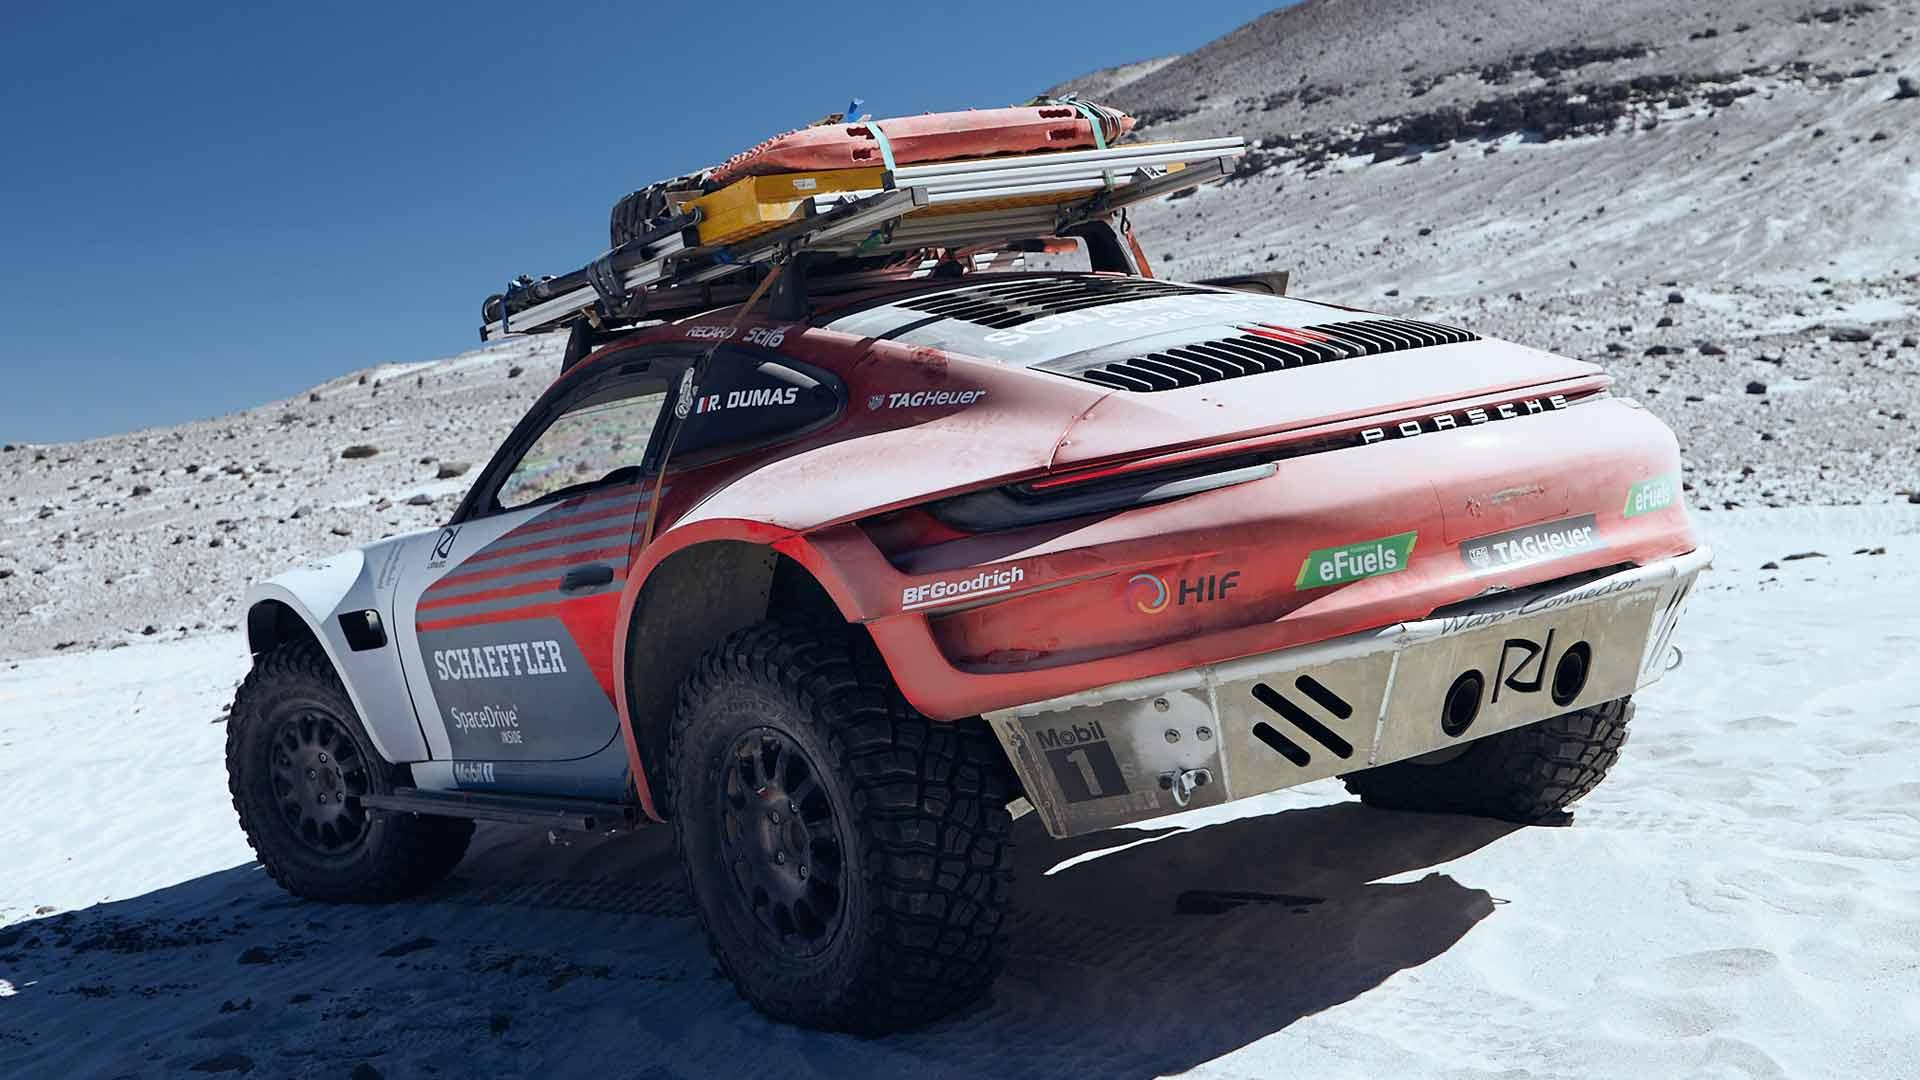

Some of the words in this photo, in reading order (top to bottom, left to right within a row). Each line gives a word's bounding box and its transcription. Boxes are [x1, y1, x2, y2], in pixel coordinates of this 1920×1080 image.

[707, 395, 721, 412] R.
[727, 387, 799, 408] DUMAS
[1361, 395, 1567, 444] PORSCHE
[1320, 543, 1397, 581] eFuels
[902, 566, 1024, 605] BFGoodrich
[1179, 571, 1240, 605] HIF
[434, 640, 566, 680] SCHAEFFLER
[1036, 720, 1106, 749] Mobil
[455, 762, 482, 783] Mobil
[1066, 749, 1103, 796] 1
